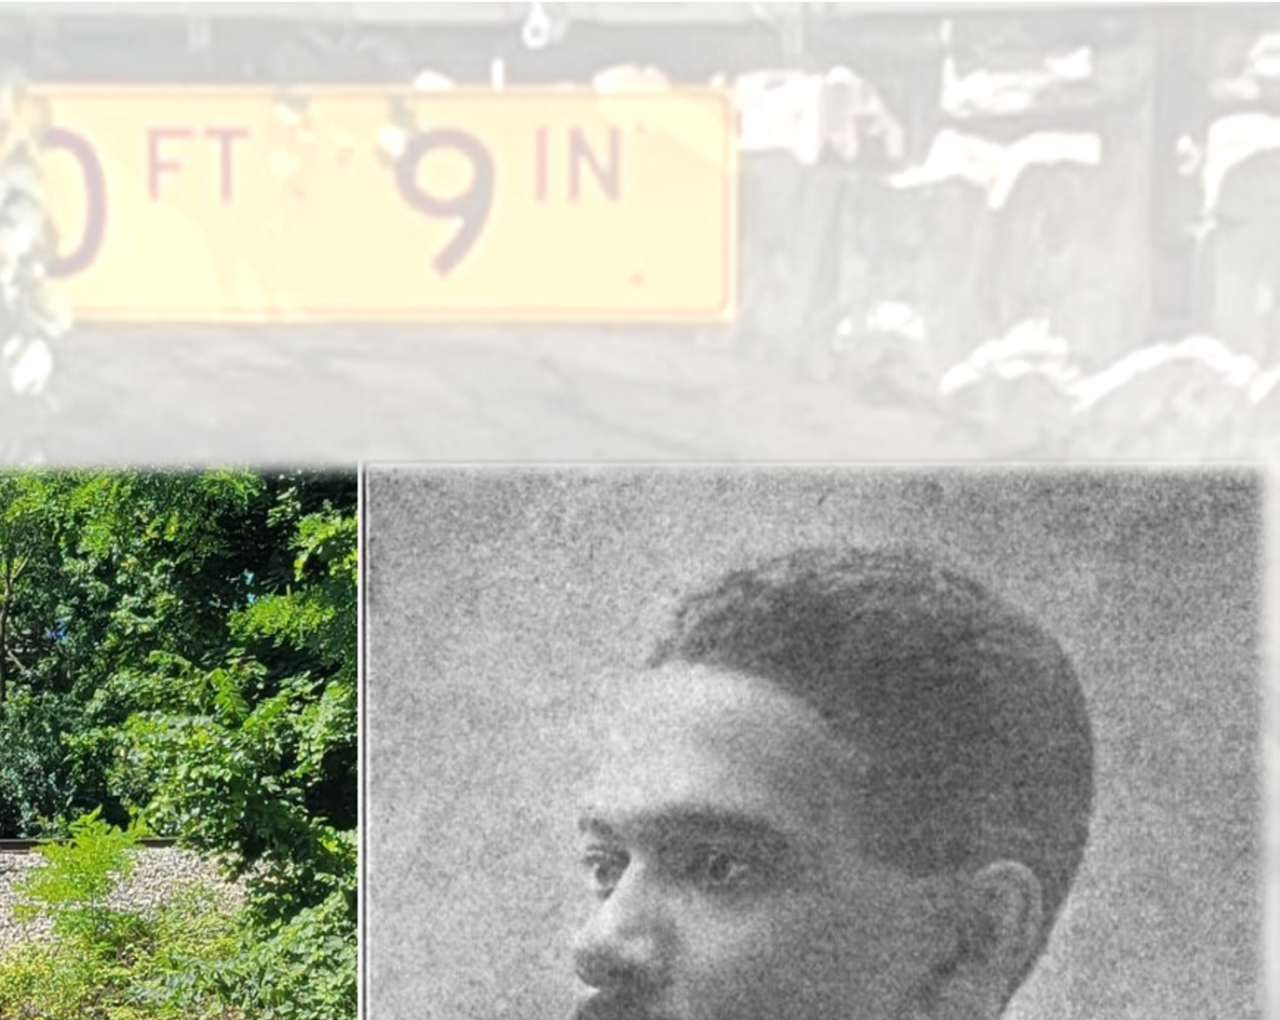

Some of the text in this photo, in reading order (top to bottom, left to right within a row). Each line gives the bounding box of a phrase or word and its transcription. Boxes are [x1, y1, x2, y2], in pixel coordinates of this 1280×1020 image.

[147, 127, 249, 202] FT
[395, 125, 496, 277] 9
[535, 127, 621, 202] IN
